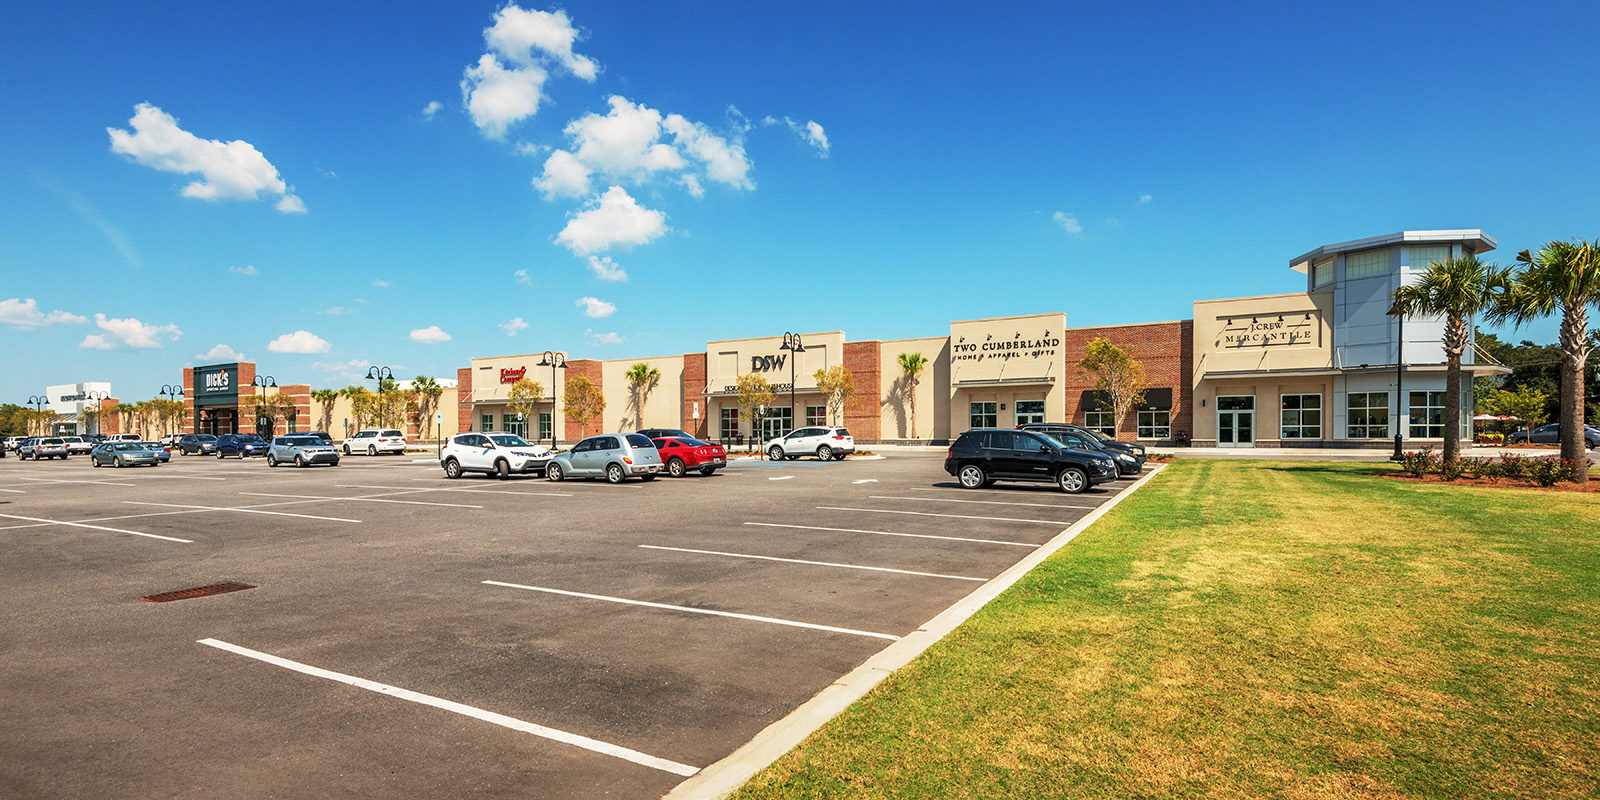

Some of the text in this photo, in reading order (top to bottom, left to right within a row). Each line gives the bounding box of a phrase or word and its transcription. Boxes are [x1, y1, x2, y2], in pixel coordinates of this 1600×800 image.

[1251, 322, 1284, 332] J.CREW
[1225, 331, 1311, 342] MERCANTILE
[954, 339, 1060, 352] TWO CUMBERLAND
[988, 351, 1020, 359] APPAREL
[751, 354, 787, 373] DSW
[206, 371, 229, 387] DICK'S
